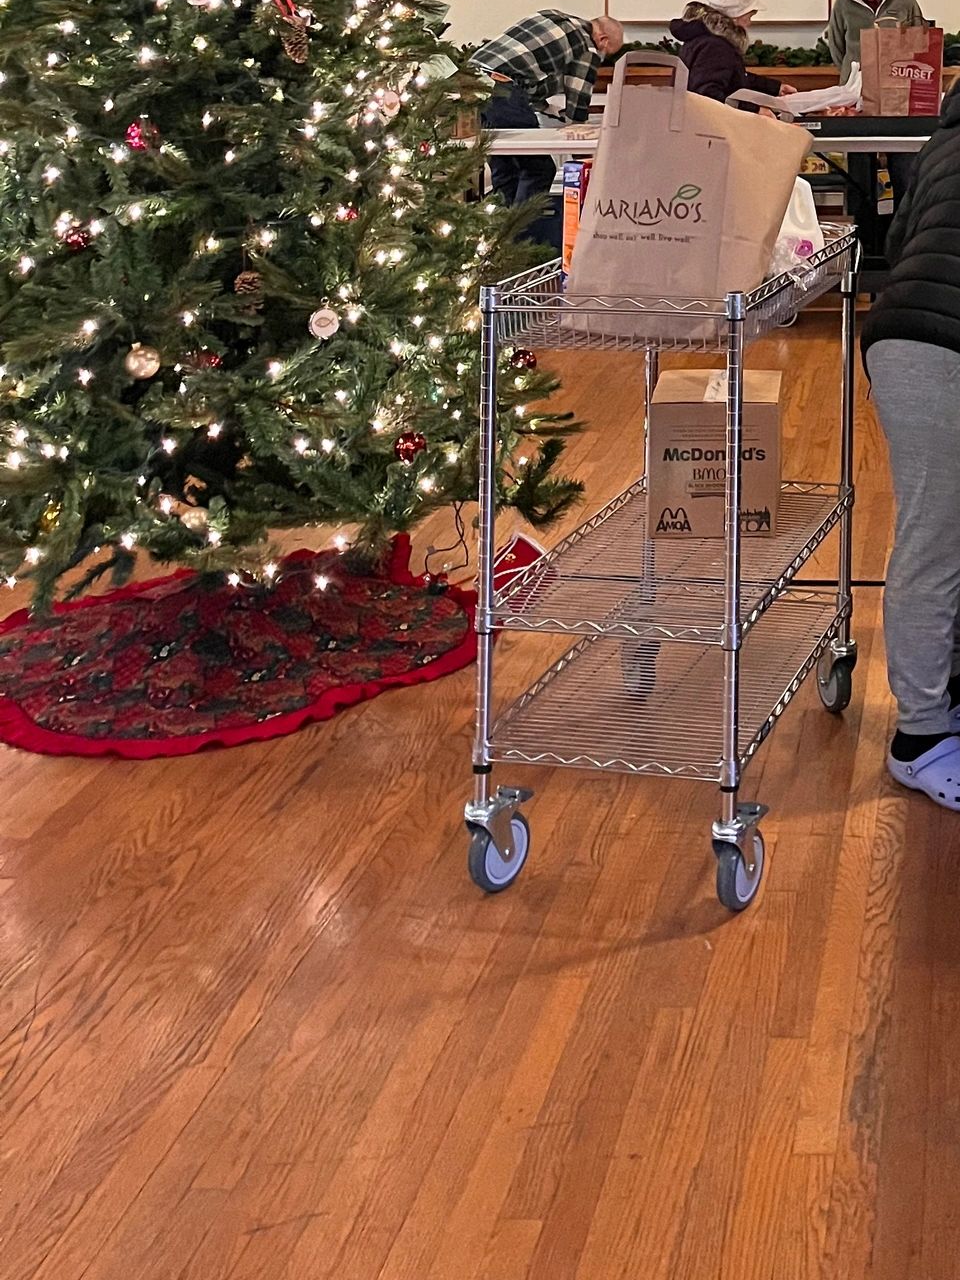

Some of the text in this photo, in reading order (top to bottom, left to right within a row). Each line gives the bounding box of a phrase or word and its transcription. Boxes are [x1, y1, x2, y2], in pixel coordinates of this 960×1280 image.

[891, 66, 934, 80] SUNSET
[592, 198, 703, 226] MARIANO'S
[662, 447, 766, 462] McDond's
